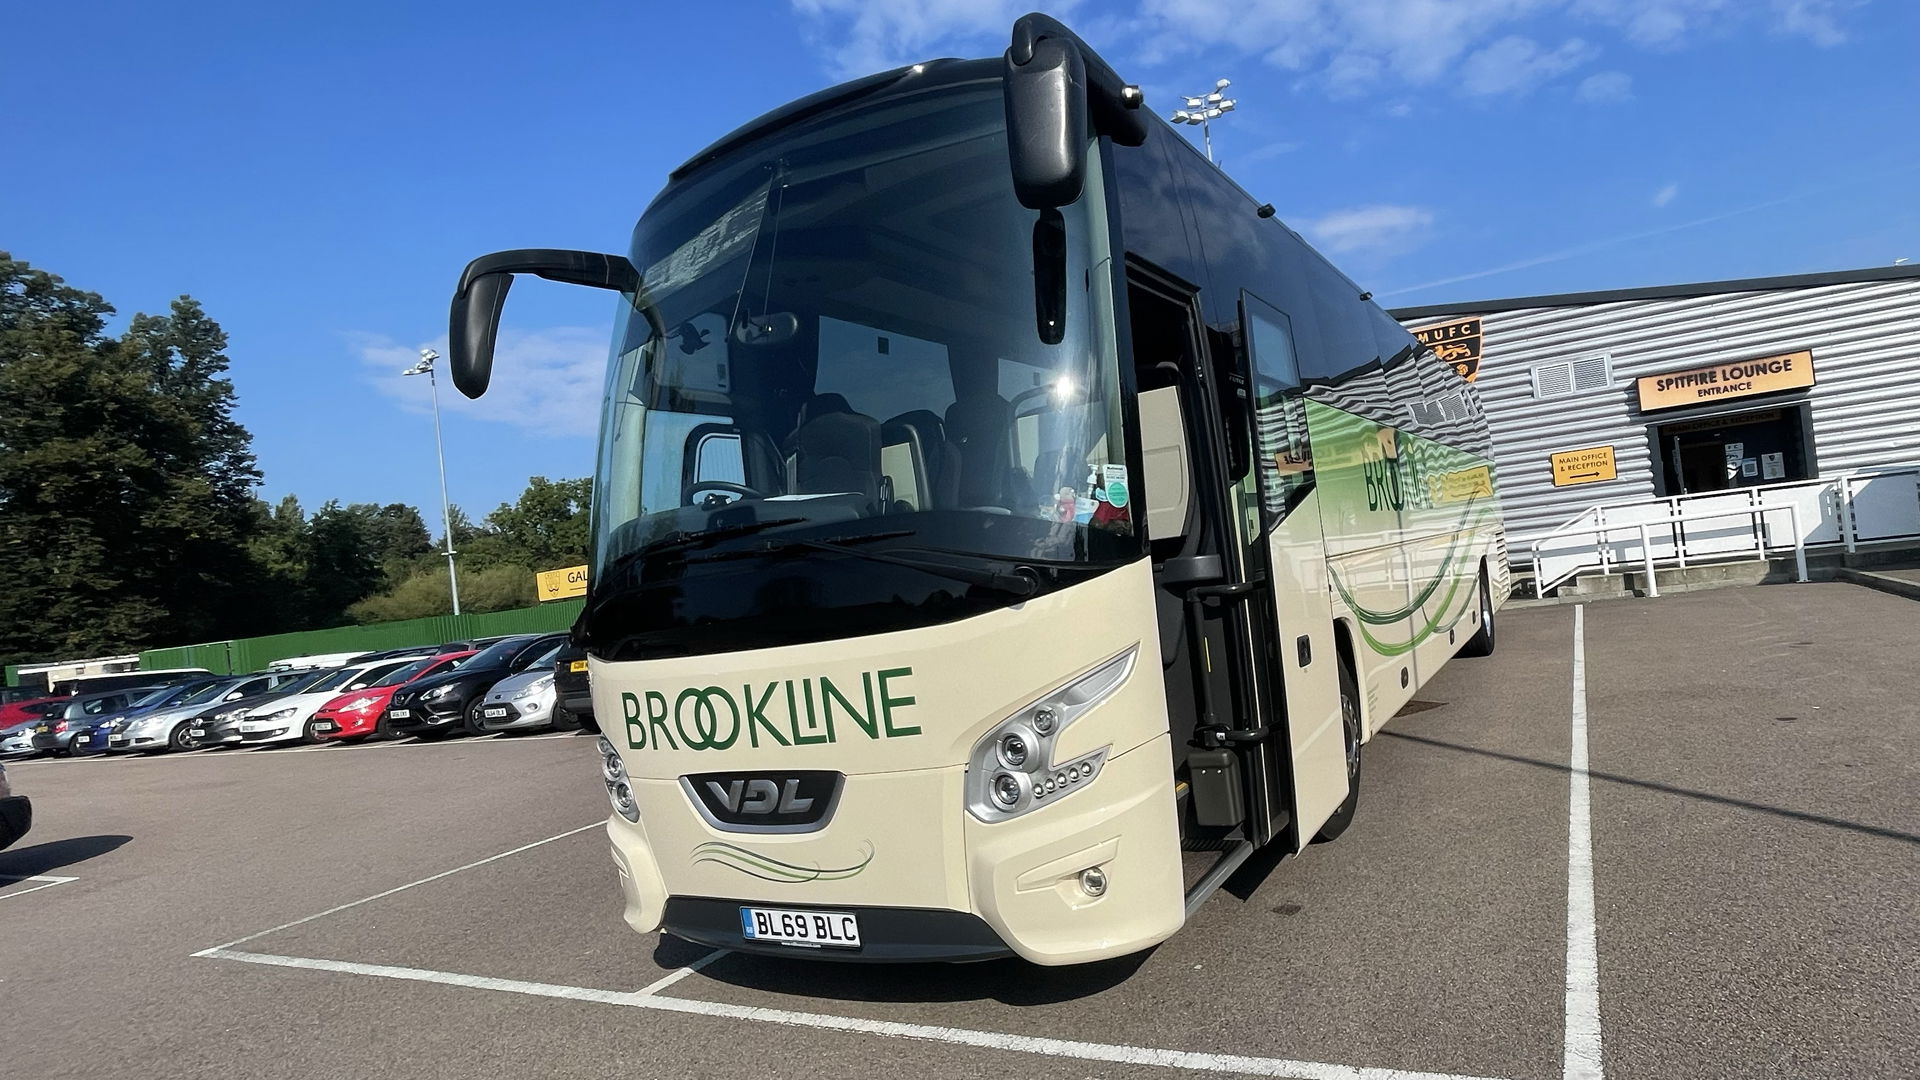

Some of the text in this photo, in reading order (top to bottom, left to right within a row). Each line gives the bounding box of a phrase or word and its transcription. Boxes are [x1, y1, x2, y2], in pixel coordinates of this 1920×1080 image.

[1418, 324, 1471, 343] MUFC
[1657, 359, 1793, 392] SPITFIRE LOUNGE
[1697, 381, 1753, 398] ENTRANCE
[1559, 452, 1607, 465] MAIN OFFICE
[1568, 460, 1608, 470] RECEPTION
[621, 666, 922, 751] BROOKLINE
[706, 779, 815, 815] VDL
[755, 912, 857, 941] BL69 BLC
